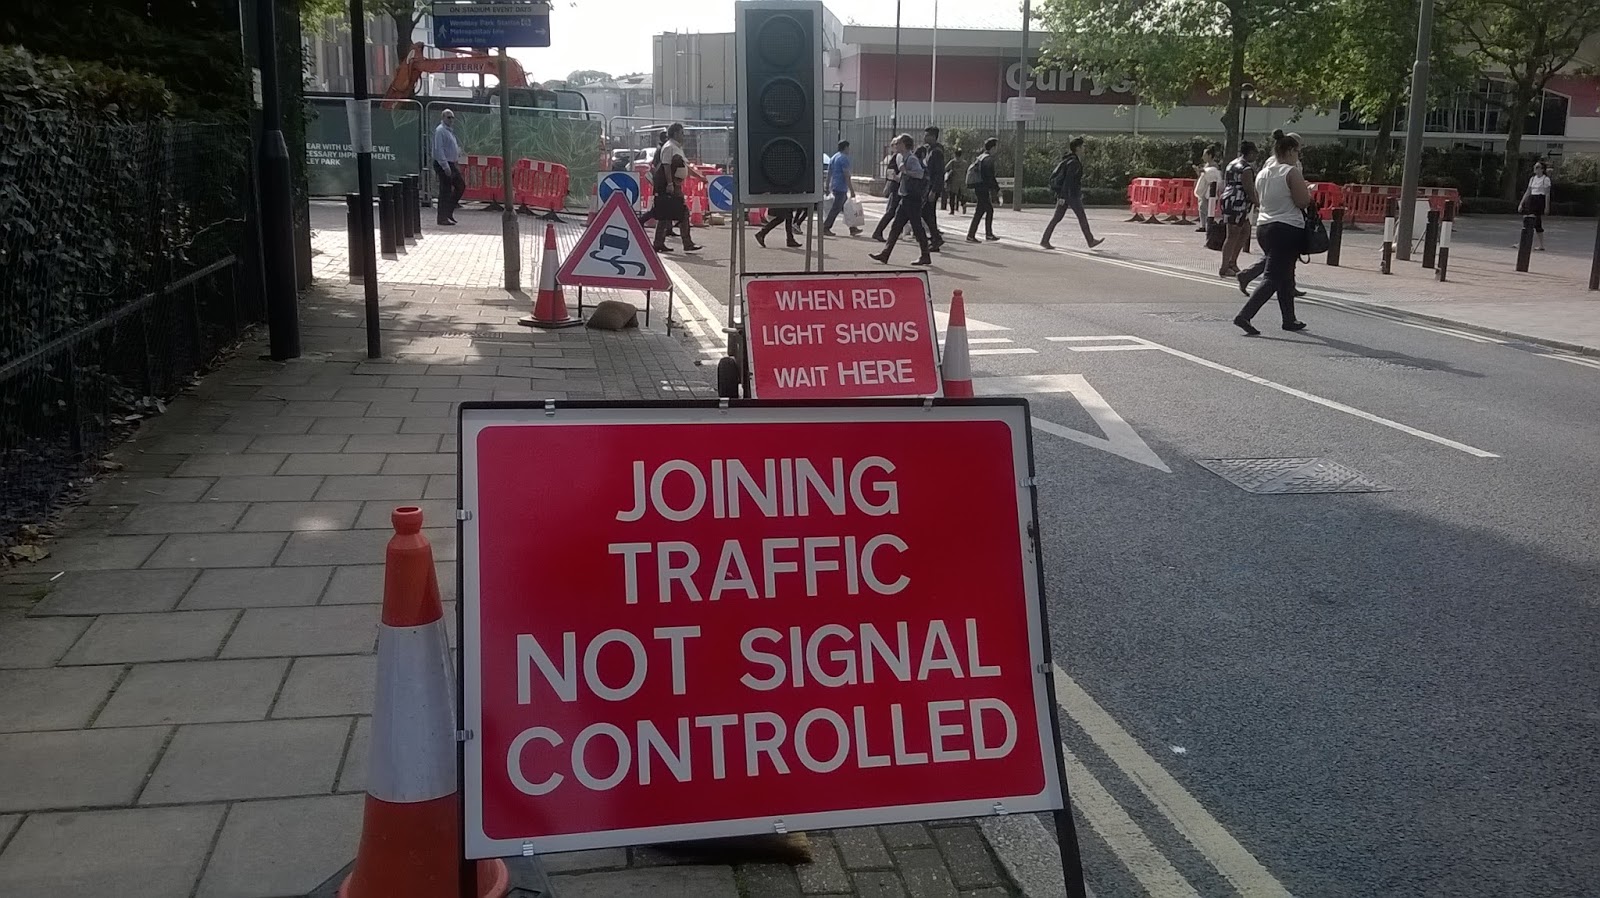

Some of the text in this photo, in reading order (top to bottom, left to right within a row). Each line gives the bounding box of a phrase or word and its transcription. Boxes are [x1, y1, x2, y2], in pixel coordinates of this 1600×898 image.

[449, 28, 491, 36] Metropolitan
[306, 142, 321, 150] EAR
[322, 143, 341, 151] WITH
[321, 158, 341, 166] PARK
[775, 288, 896, 311] WHEN RED
[762, 321, 919, 346] LIGHT SHOWS
[774, 358, 916, 389] WAIT HERE
[615, 456, 900, 522] JOINING
[608, 534, 911, 604] TRAFFIC
[516, 618, 1002, 705] NOT SIGNAL
[506, 697, 1018, 796] CONTROLLED
